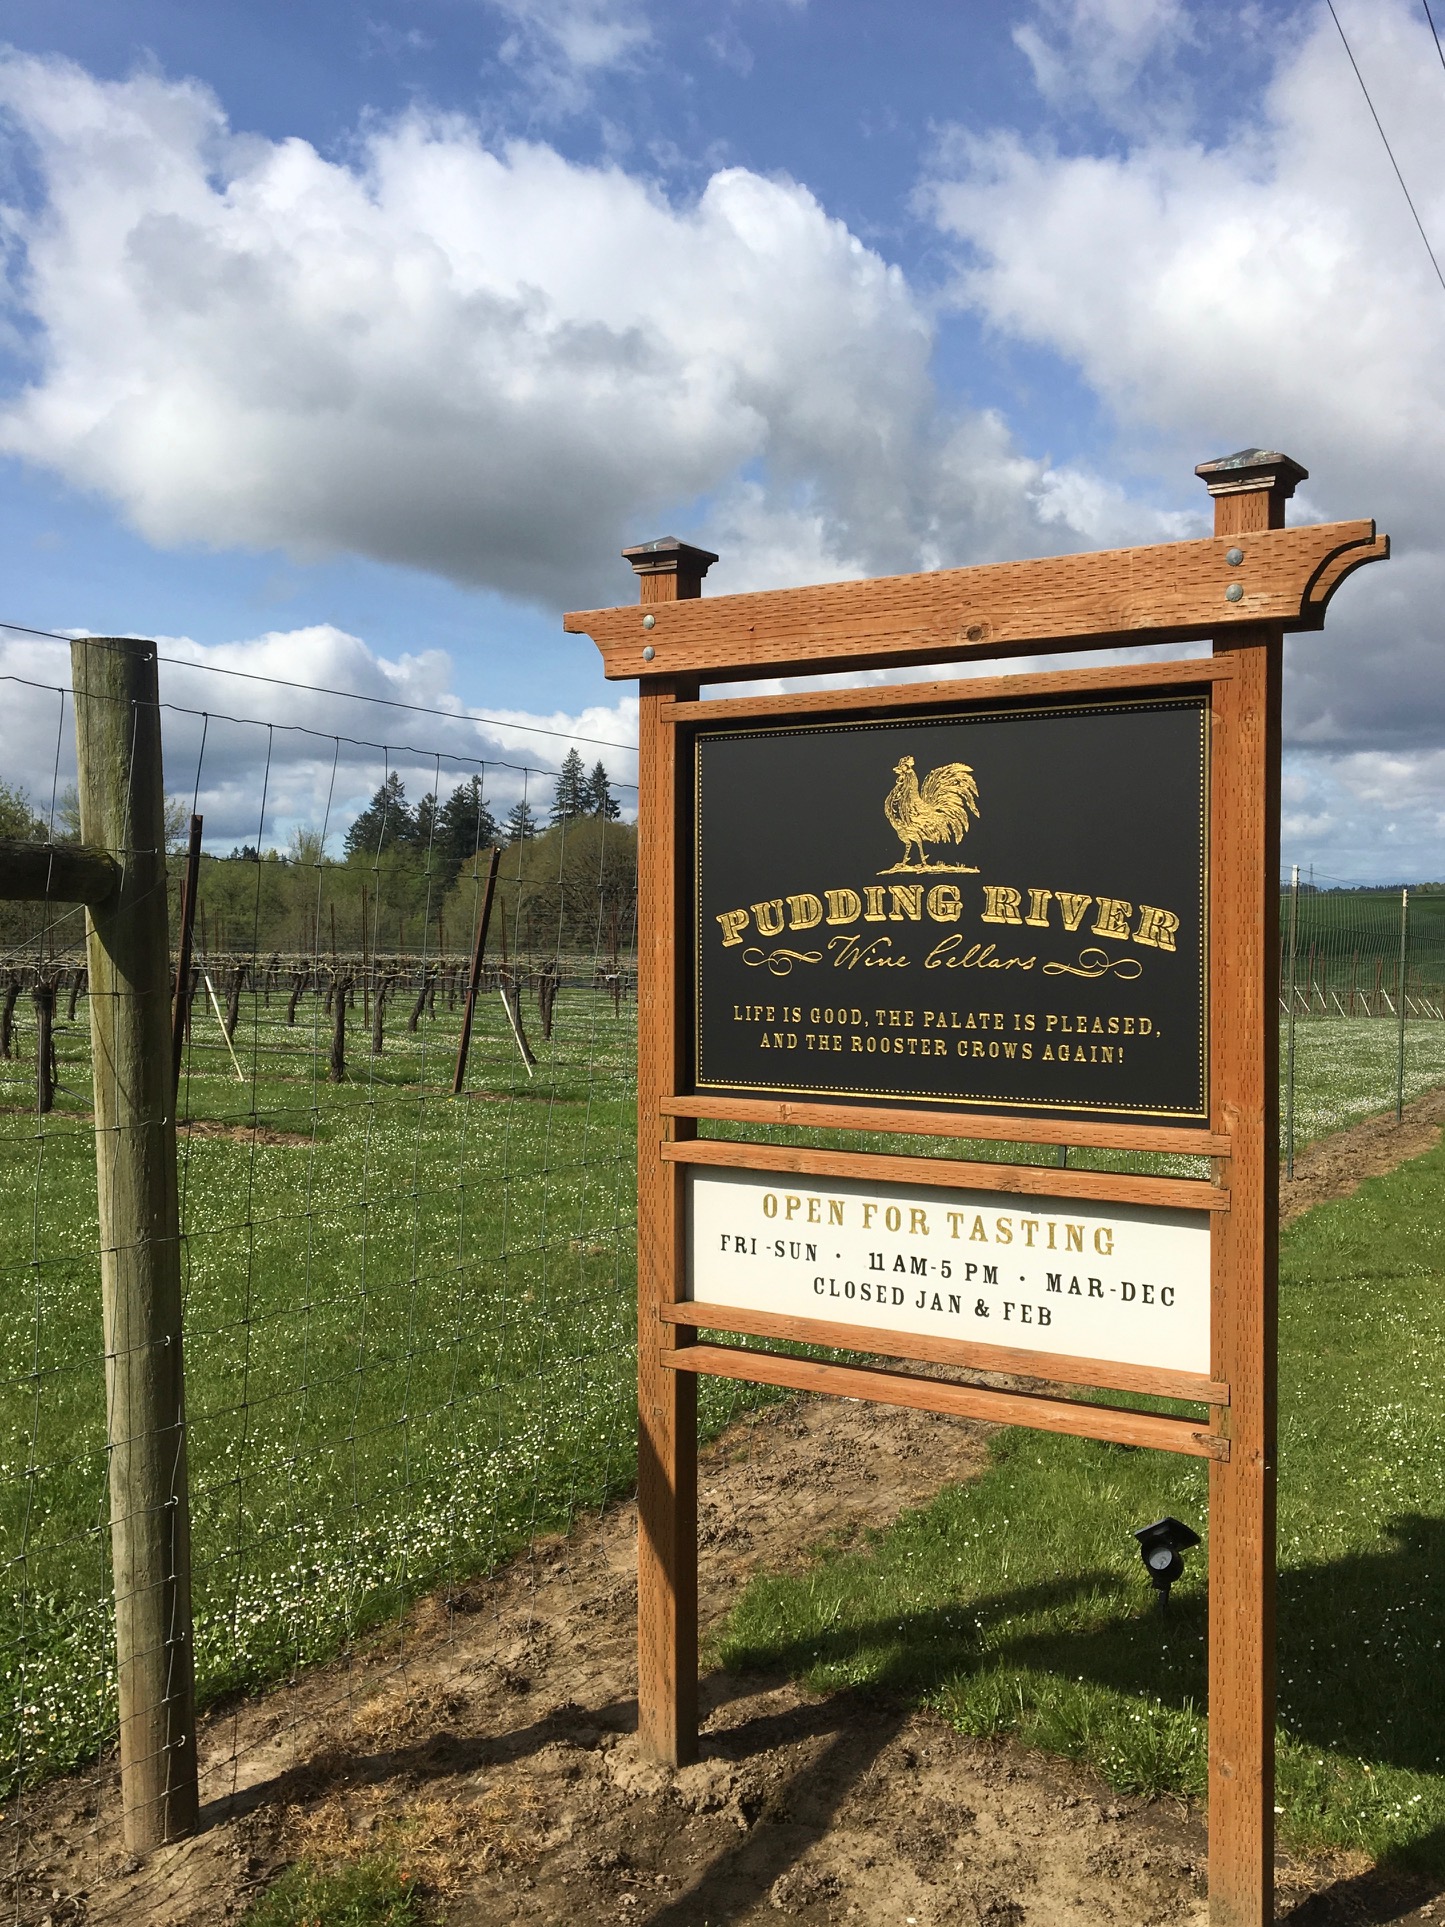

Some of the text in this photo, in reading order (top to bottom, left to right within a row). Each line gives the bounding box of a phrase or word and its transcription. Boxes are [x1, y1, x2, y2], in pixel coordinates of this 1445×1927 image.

[715, 884, 1181, 952] PUDDING RIVER
[827, 933, 1037, 971] Wine Cellars
[733, 1005, 1161, 1038] LIFE IS GOOD, THE PALATE IS PLEASED,
[759, 1032, 1124, 1064] AND THE ROOSTER CROWS AGAIN!
[762, 1193, 1116, 1256] OPEN FOR TASTING
[813, 1276, 1052, 1327] CLOSED JAN & FEB
[964, 1262, 999, 1286] PM
[1045, 1272, 1176, 1308] MAR-DEC
